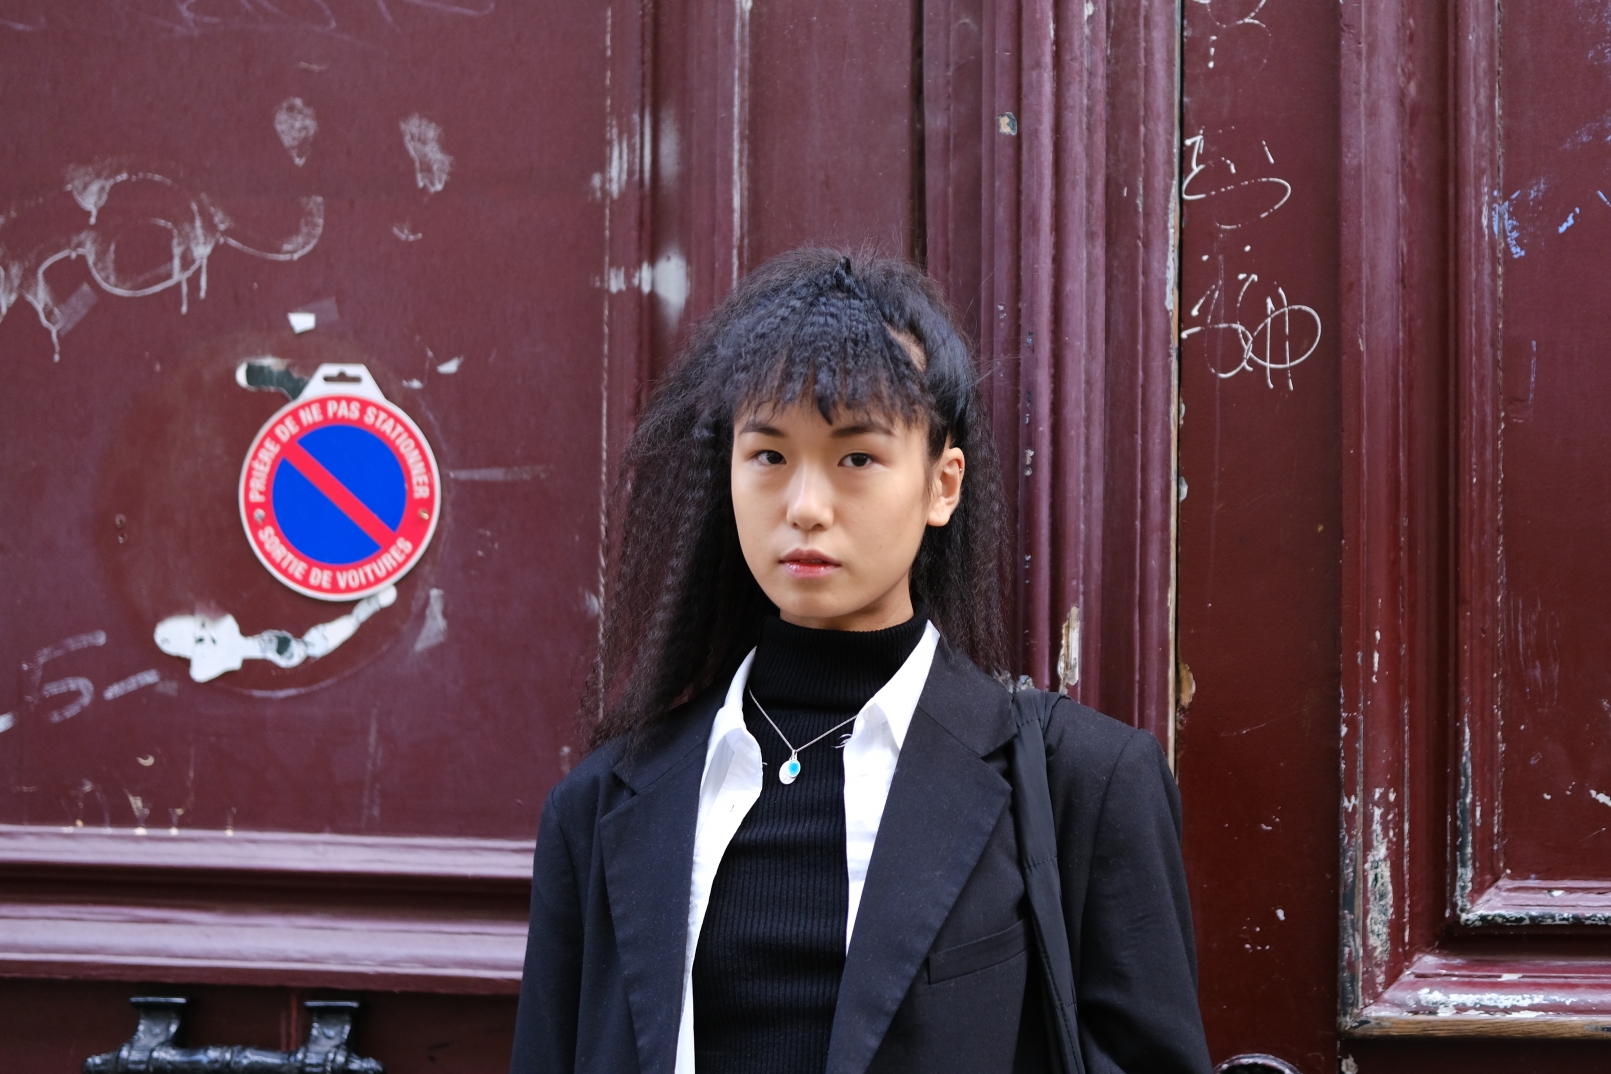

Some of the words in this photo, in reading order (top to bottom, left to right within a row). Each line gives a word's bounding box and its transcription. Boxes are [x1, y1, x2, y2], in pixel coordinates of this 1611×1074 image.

[274, 415, 300, 443] DE
[299, 403, 323, 427] NE
[327, 400, 360, 420] PAS
[364, 406, 430, 499] STATIONNER
[258, 525, 307, 580] SORTIE
[309, 568, 332, 589] DE
[336, 537, 413, 589] VOITURES
